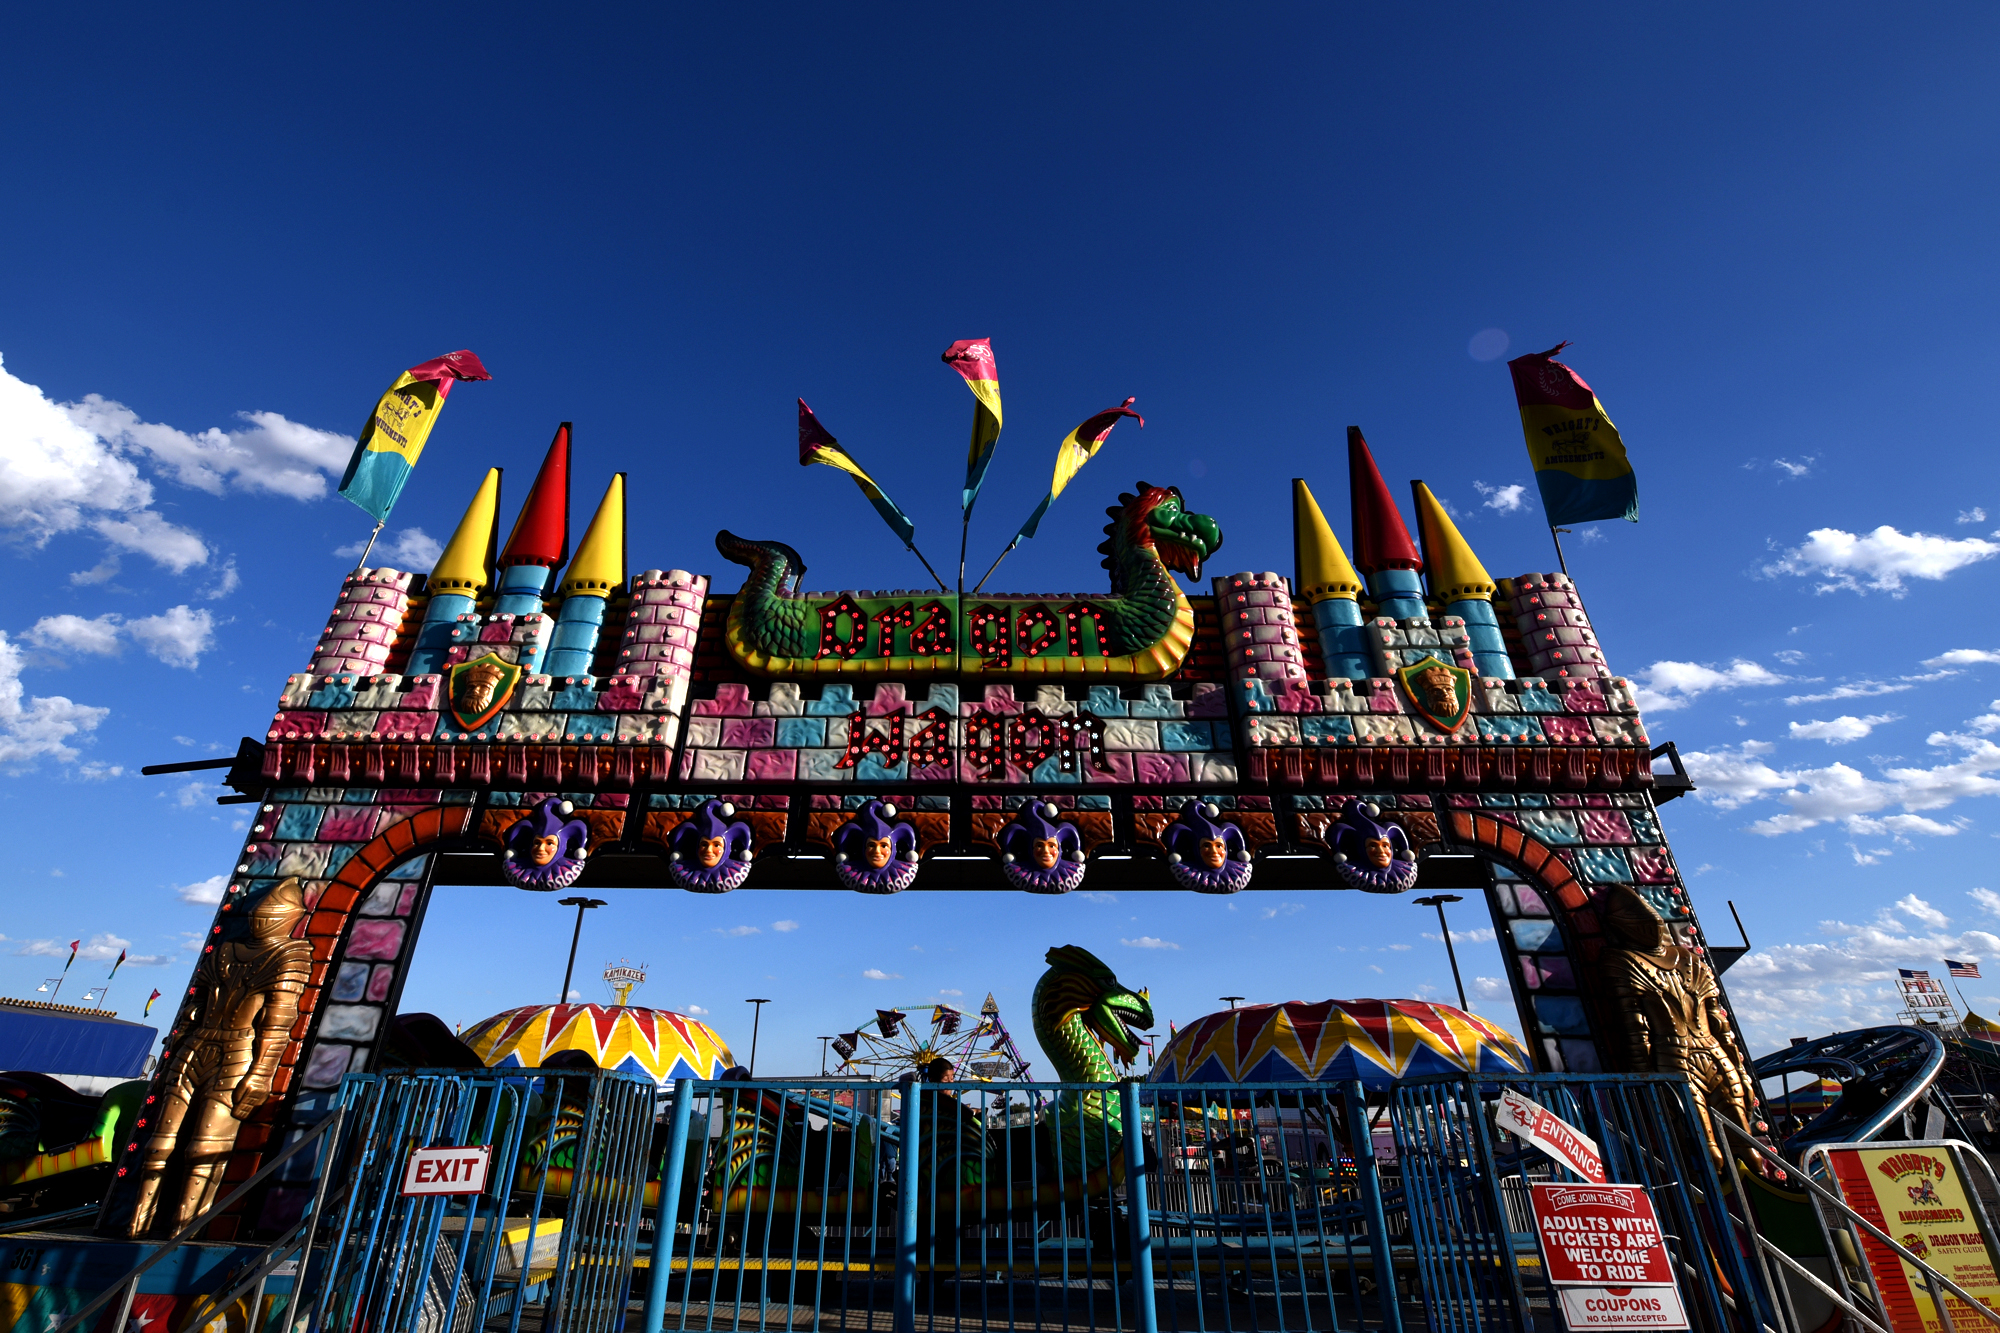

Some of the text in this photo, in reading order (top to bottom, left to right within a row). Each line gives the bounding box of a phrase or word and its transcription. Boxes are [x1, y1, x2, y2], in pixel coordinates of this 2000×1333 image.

[375, 416, 408, 449] MUSEMENTS
[1541, 417, 1600, 437] WRIGHT'S
[1544, 451, 1605, 466] AMUSEMENTS
[812, 593, 1113, 670] Dragon
[603, 968, 645, 982] KAMIKAZEE
[1905, 994, 1952, 1007] SLIDE
[1540, 1118, 1603, 1178] ENTRANCE
[415, 1158, 480, 1183] EXIT
[1877, 1153, 1946, 1183] WRIGHT'S
[1556, 1193, 1629, 1207] COME JOIN THE FUN
[1898, 1208, 1965, 1224] AMUSEMENTS
[1543, 1216, 1655, 1232] ADULTS WITH
[1546, 1231, 1658, 1248] TICKETS ARE
[1896, 1232, 1924, 1247] Read
[1928, 1234, 1961, 1247] DRAGON
[1564, 1248, 1650, 1264] WELCOME
[1914, 1250, 1932, 1259] ide
[1577, 1264, 1647, 1280] TO RIDE
[1585, 1298, 1661, 1312] COUPONS
[1944, 1299, 1956, 1308] OU
[1601, 1315, 1624, 1323] CASH
[1626, 1314, 1667, 1322] ACCEPTED
[1926, 1320, 1939, 1330] TO
[1958, 1319, 1983, 1329] WITH
